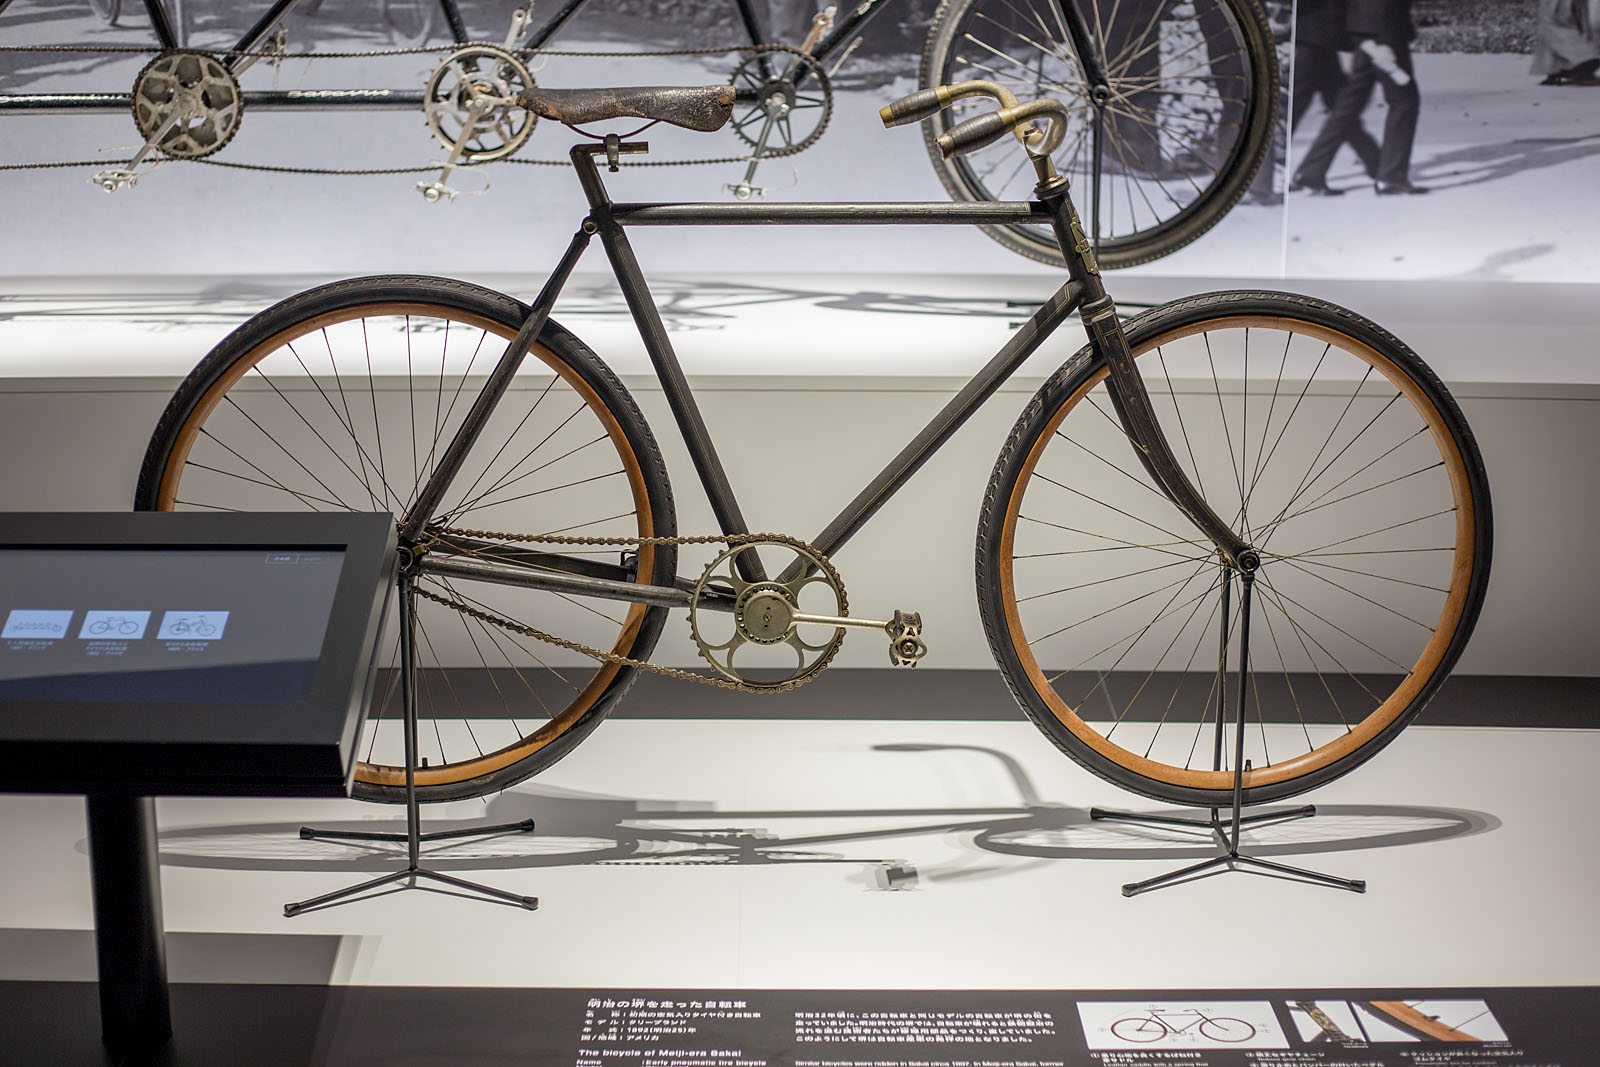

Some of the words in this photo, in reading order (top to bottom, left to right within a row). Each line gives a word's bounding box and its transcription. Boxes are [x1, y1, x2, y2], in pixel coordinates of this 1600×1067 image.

[579, 1049, 599, 1057] The
[602, 1049, 641, 1057] bicycle
[644, 1049, 656, 1057] of
[658, 1049, 707, 1057] Meiji-era
